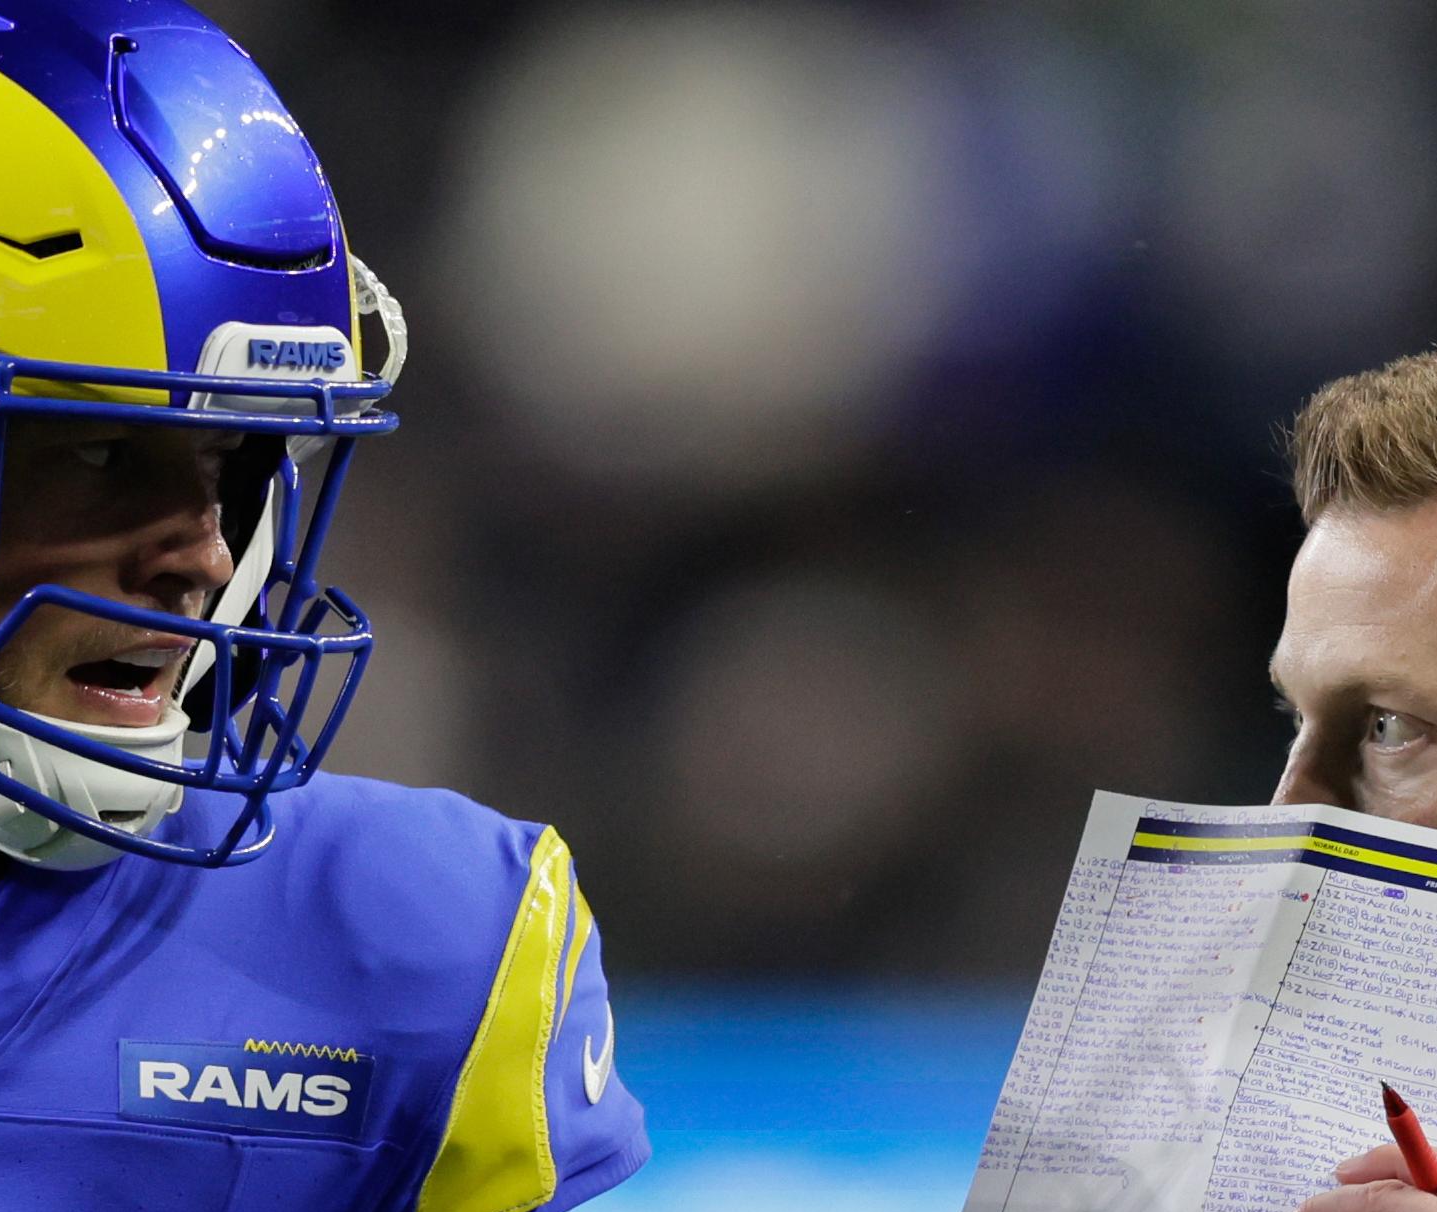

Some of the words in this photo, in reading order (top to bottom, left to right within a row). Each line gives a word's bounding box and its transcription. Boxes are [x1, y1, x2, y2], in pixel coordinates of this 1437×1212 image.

[247, 338, 346, 369] RAMS
[1314, 841, 1342, 853] NORMAL
[139, 1061, 351, 1116] RAMS
